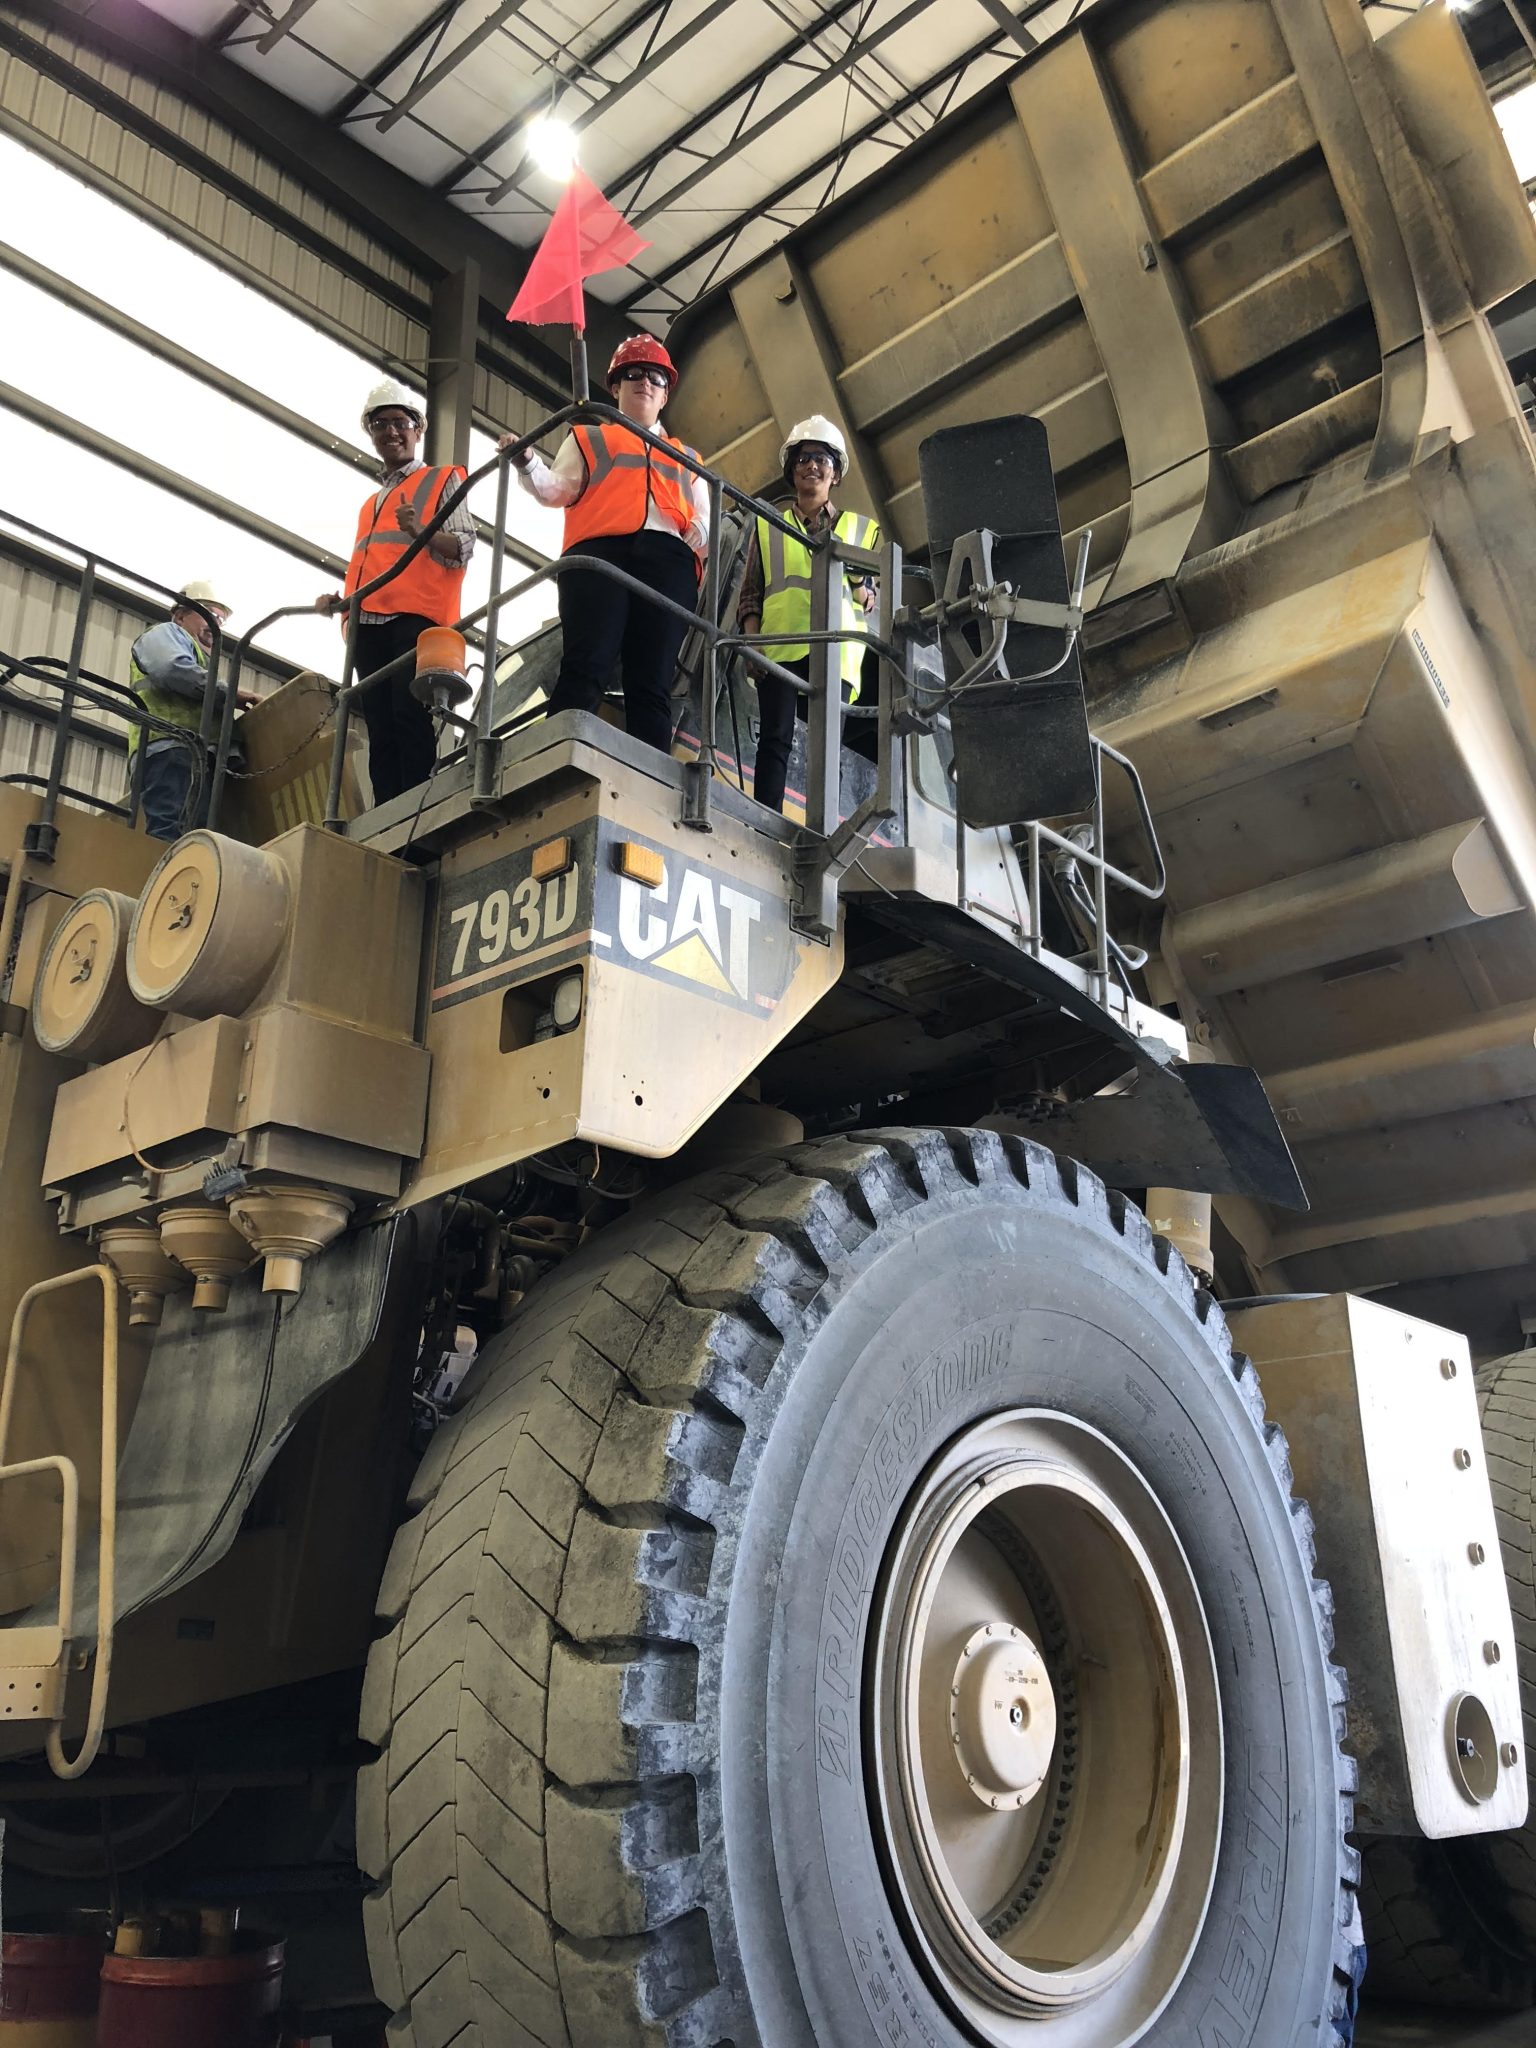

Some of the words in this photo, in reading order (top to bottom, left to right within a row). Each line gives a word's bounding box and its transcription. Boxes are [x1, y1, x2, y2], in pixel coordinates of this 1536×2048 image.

[450, 861, 579, 977] 793D
[618, 863, 761, 1001] CAT
[816, 1323, 1015, 1785] BRIDGESTONE
